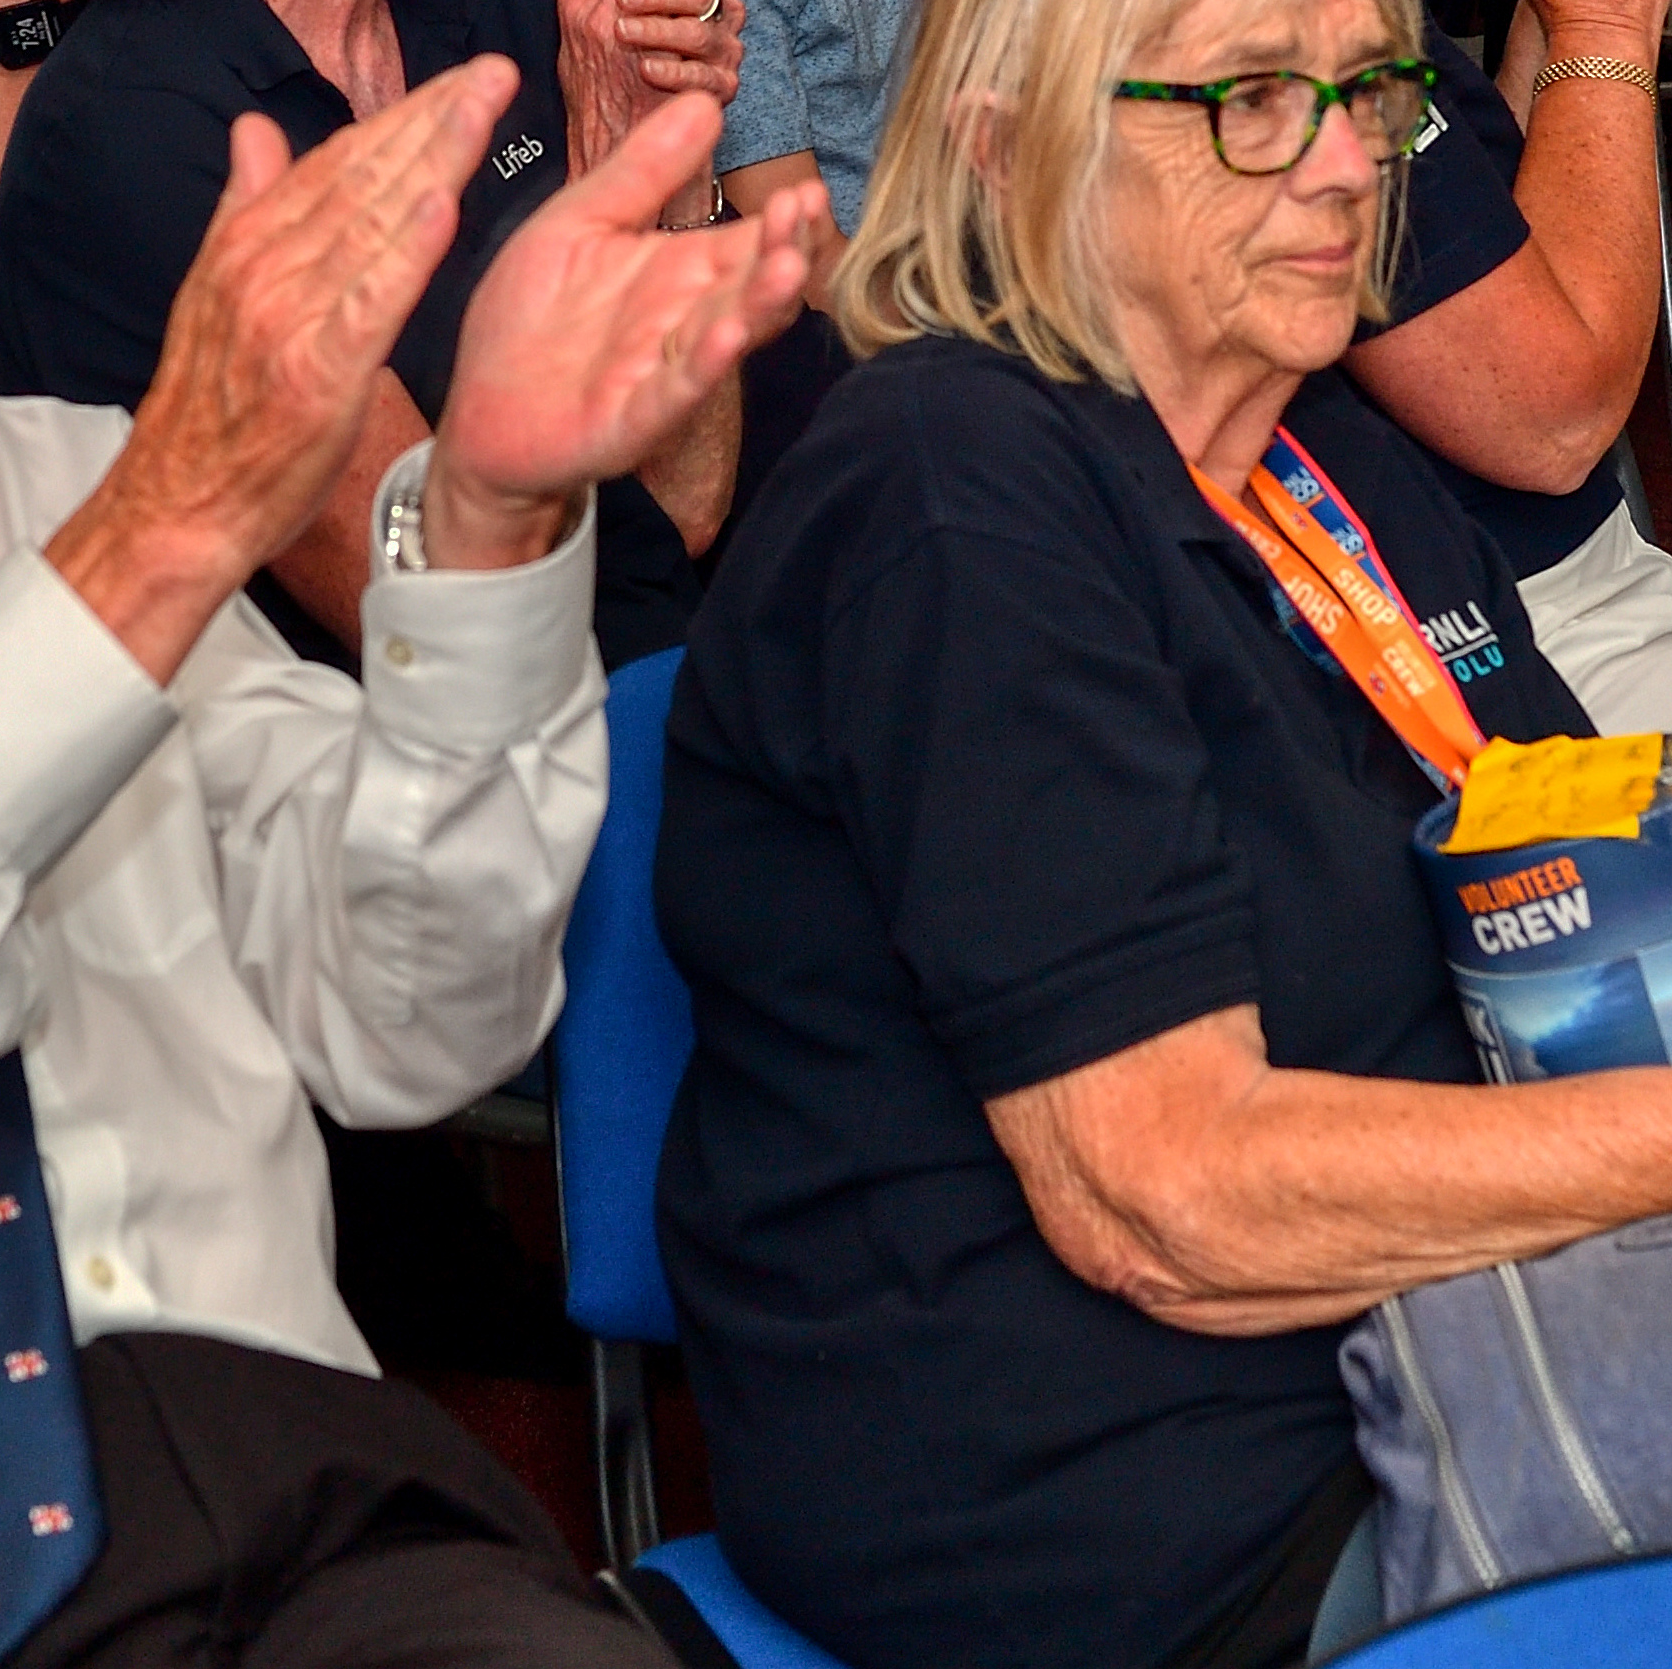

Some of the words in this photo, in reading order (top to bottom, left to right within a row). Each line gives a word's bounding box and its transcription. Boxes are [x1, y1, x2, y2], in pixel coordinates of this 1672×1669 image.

[492, 134, 544, 180] Lifeb
[1332, 568, 1398, 625] SHOP
[1419, 599, 1491, 654] RNLI
[1447, 644, 1504, 683] OLU
[1456, 855, 1583, 915] VOLUNTEER
[1471, 886, 1592, 955] CREW
